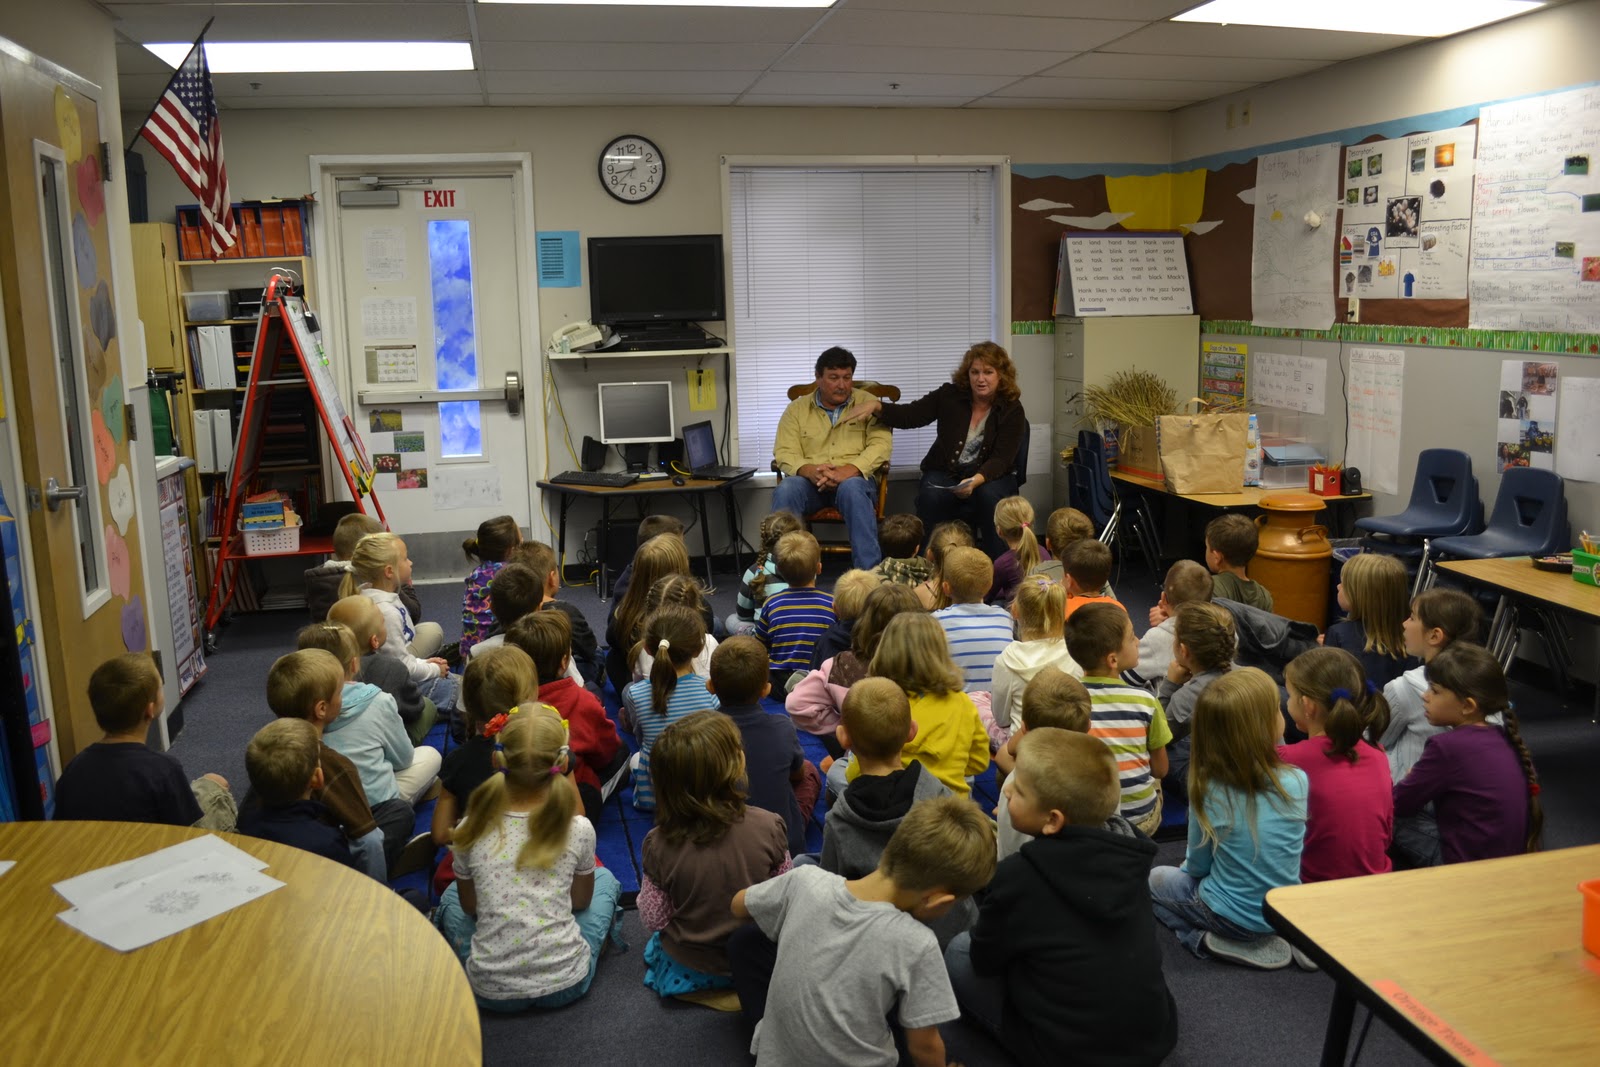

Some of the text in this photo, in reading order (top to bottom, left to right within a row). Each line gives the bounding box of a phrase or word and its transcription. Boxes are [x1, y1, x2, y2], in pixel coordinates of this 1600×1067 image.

[625, 143, 637, 154] 12
[638, 146, 643, 156] 1
[645, 152, 653, 163] 2
[606, 164, 614, 175] 9
[650, 165, 658, 175] 3
[611, 175, 618, 186] 8
[647, 175, 654, 185] 4
[619, 183, 627, 193] 7
[629, 185, 637, 195] 6
[639, 182, 647, 192] 5
[424, 190, 456, 208] EXIT
[1421, 222, 1450, 236] Interesting
